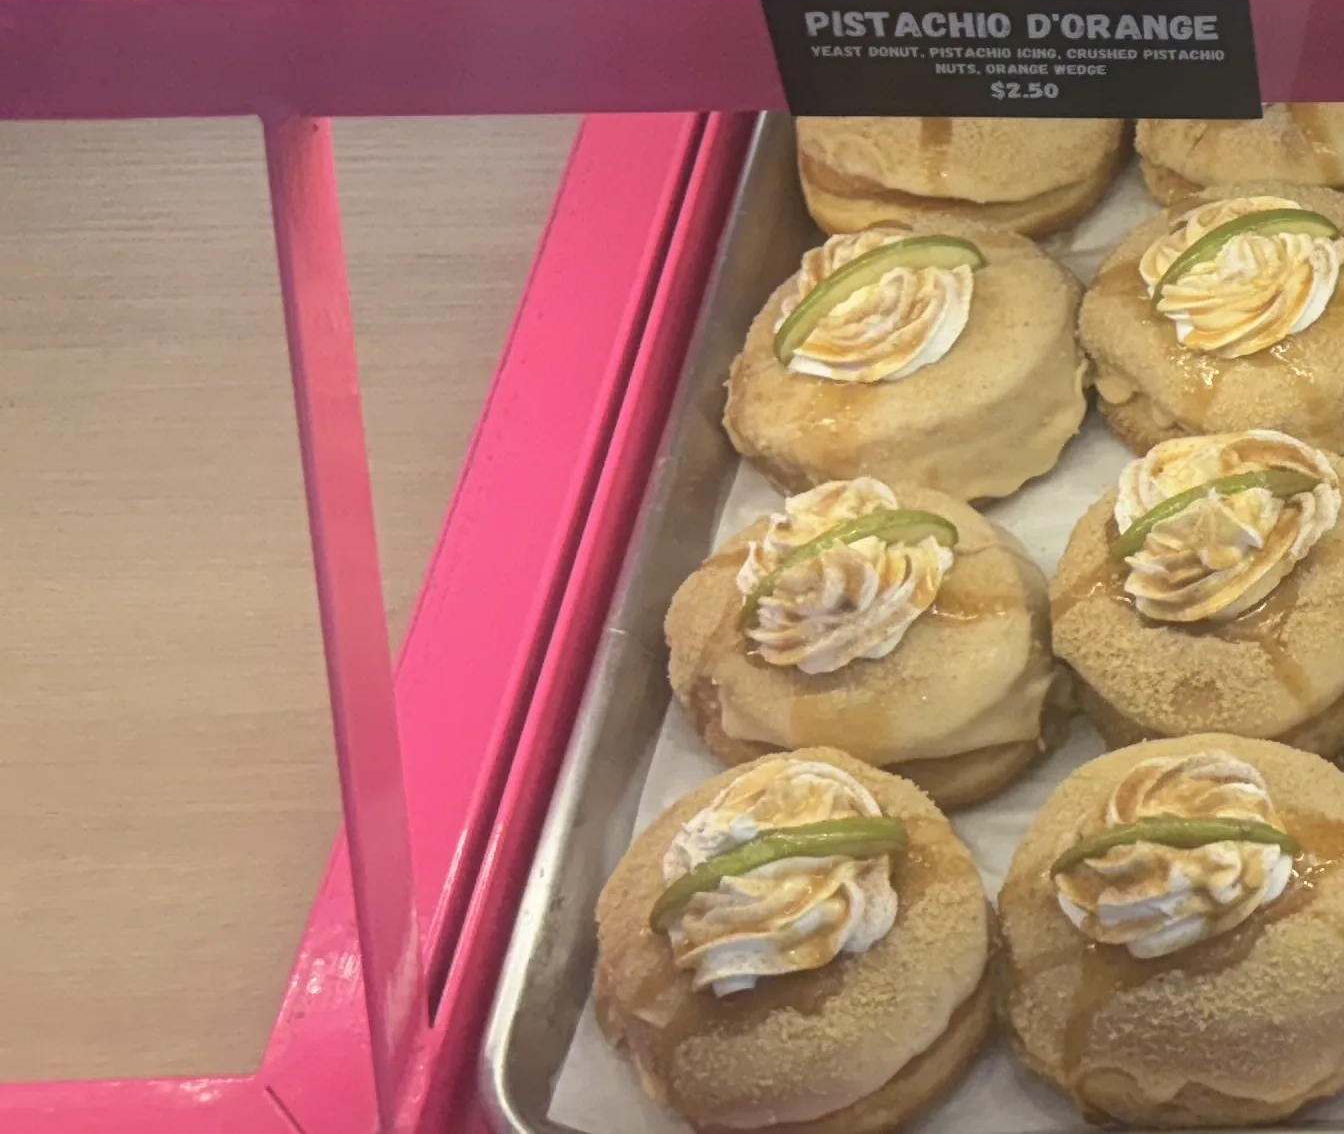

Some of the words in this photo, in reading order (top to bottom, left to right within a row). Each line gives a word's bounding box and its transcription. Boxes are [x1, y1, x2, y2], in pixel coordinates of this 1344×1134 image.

[804, 10, 1011, 39] PISTACHIO
[1026, 13, 1219, 40] D'ORANGE
[811, 45, 863, 57] YEAST
[929, 47, 1012, 59] PISTACHIO
[1016, 47, 1062, 60] ICING,
[1066, 48, 1138, 60] CRUSHED
[1143, 49, 1225, 61] PISTACHIO
[985, 63, 1049, 75] ORANGE
[1053, 64, 1107, 75] WEDGE
[990, 80, 1059, 99] $2.50
